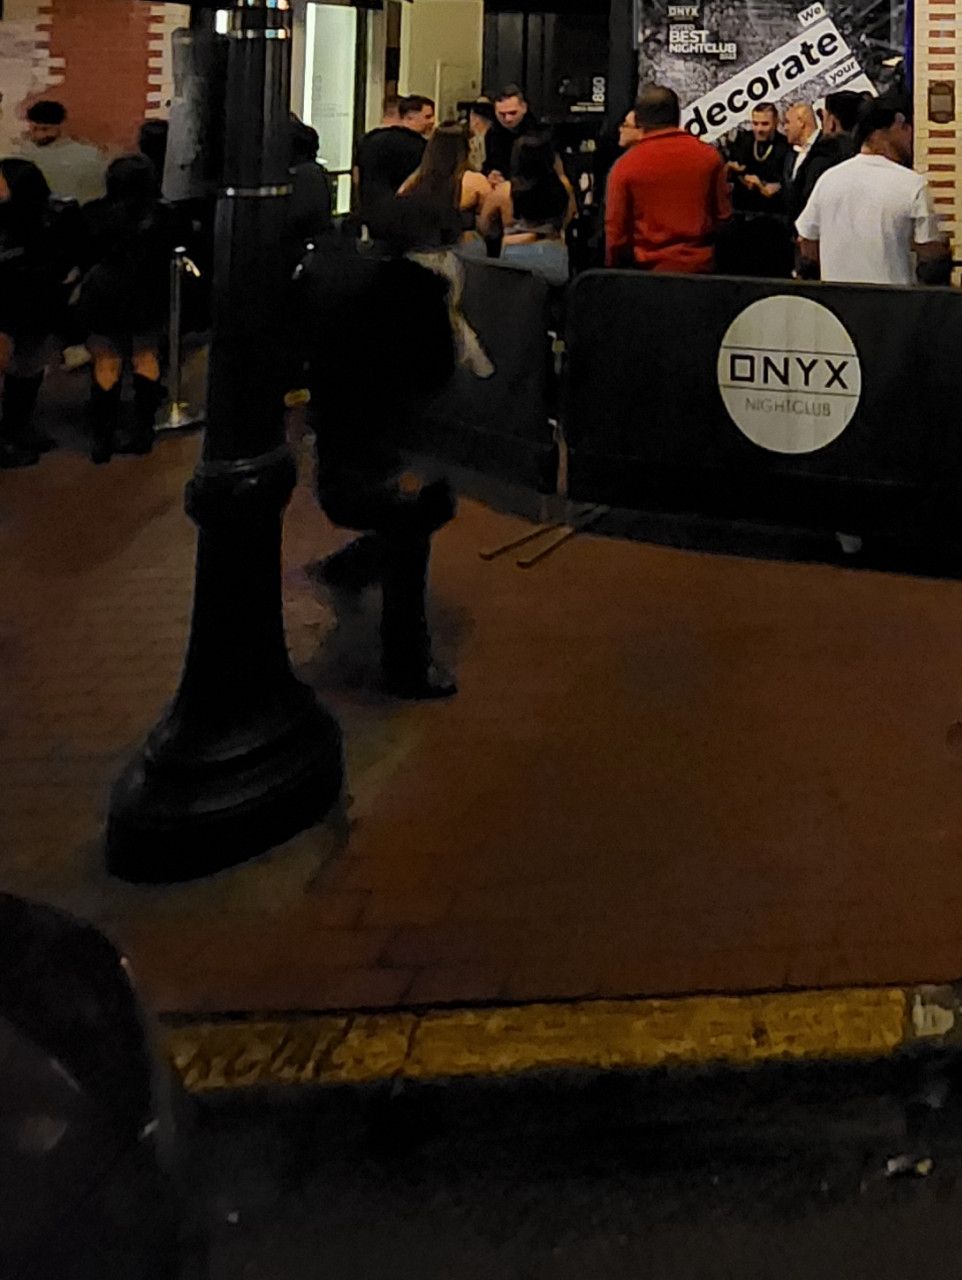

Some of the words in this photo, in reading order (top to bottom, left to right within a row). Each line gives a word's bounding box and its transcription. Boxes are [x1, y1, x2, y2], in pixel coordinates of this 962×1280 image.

[668, 6, 699, 17] ONYX
[800, 4, 822, 22] We
[669, 30, 710, 43] BEST
[669, 43, 736, 53] NIGHTCLUB
[829, 62, 856, 82] your
[685, 32, 838, 137] decorate
[730, 354, 849, 389] ONYX
[745, 398, 831, 417] NIGHTCLUB
